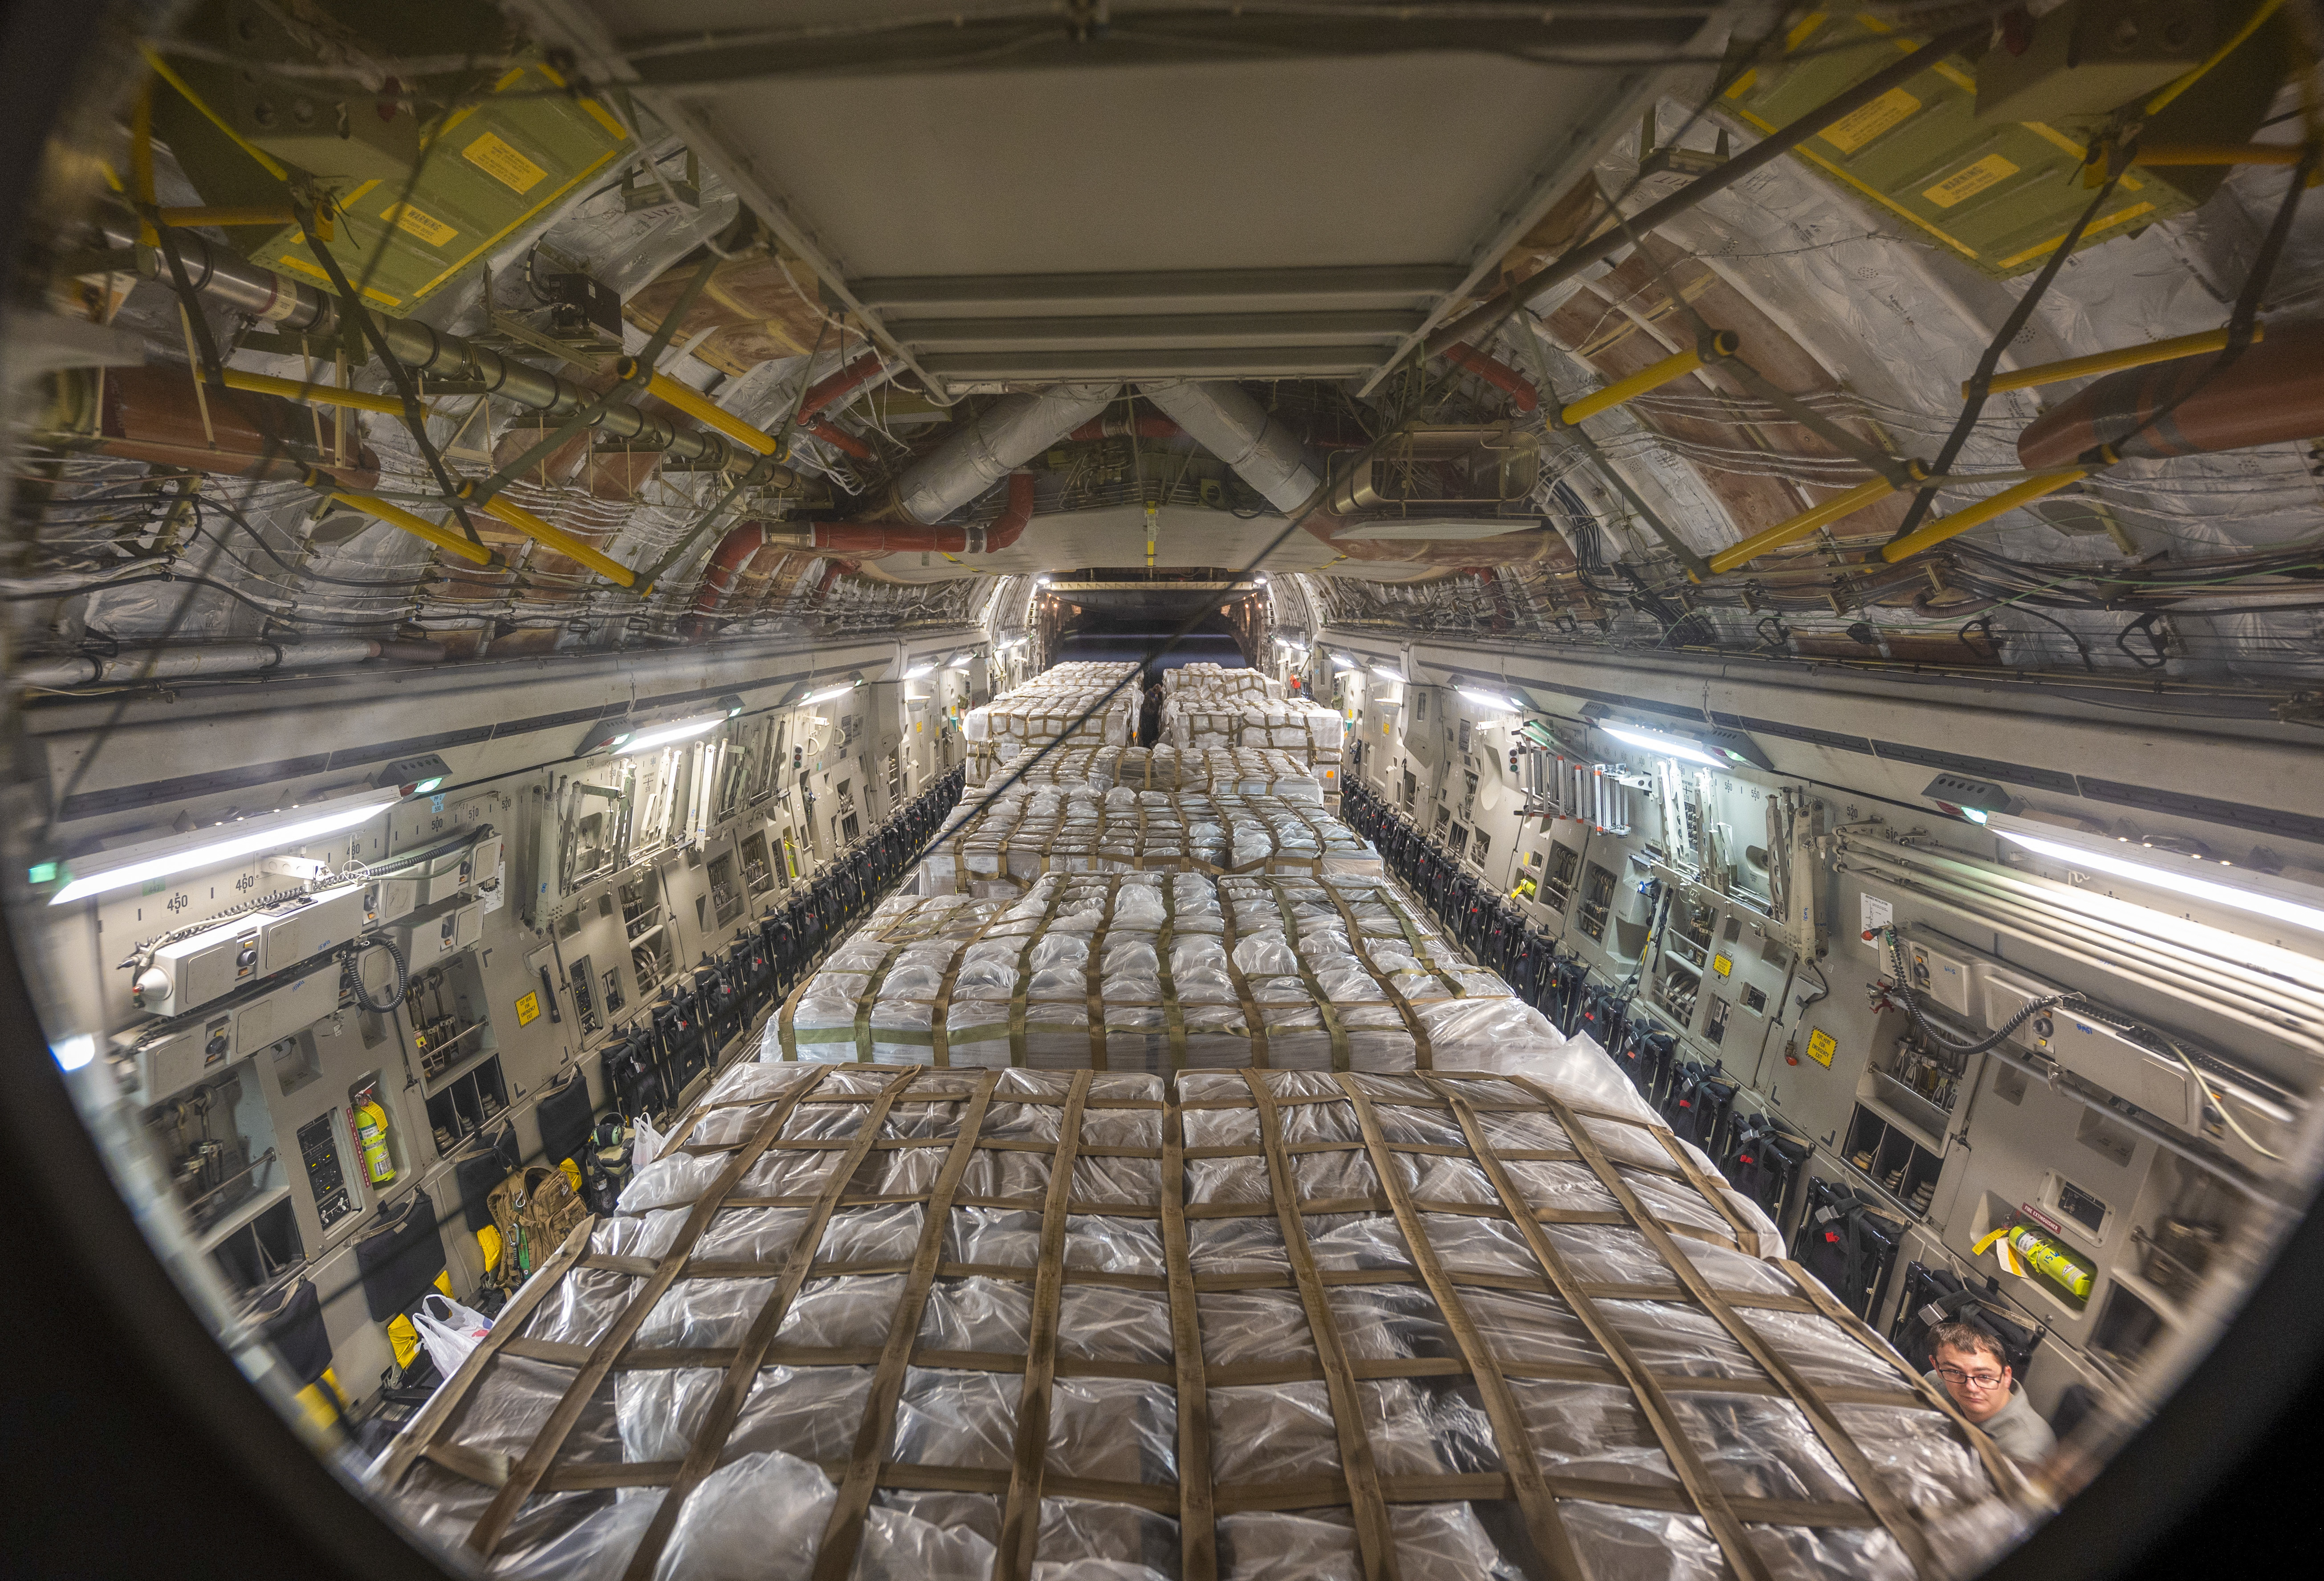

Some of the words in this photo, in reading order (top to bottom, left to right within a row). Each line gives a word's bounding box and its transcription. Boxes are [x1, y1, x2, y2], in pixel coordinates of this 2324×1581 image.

[1653, 177, 1694, 187] XIT
[407, 209, 444, 232] WARNING
[1751, 789, 1760, 799] 550
[502, 798, 511, 809] 520
[468, 807, 479, 819] 510
[1847, 806, 1858, 818] 520
[431, 818, 443, 830] 500
[346, 843, 360, 855] 480
[236, 876, 254, 890] 460
[167, 894, 188, 911] 450
[521, 1005, 536, 1017] EMERGENCY
[1823, 1037, 1831, 1045] HERE
[1811, 1043, 1829, 1057] EMERGENCY
[353, 1132, 370, 1187] EXTINGUISHER
[2024, 1205, 2033, 1214] FIRE
[2032, 1209, 2058, 1231] EXTINGUISHER
